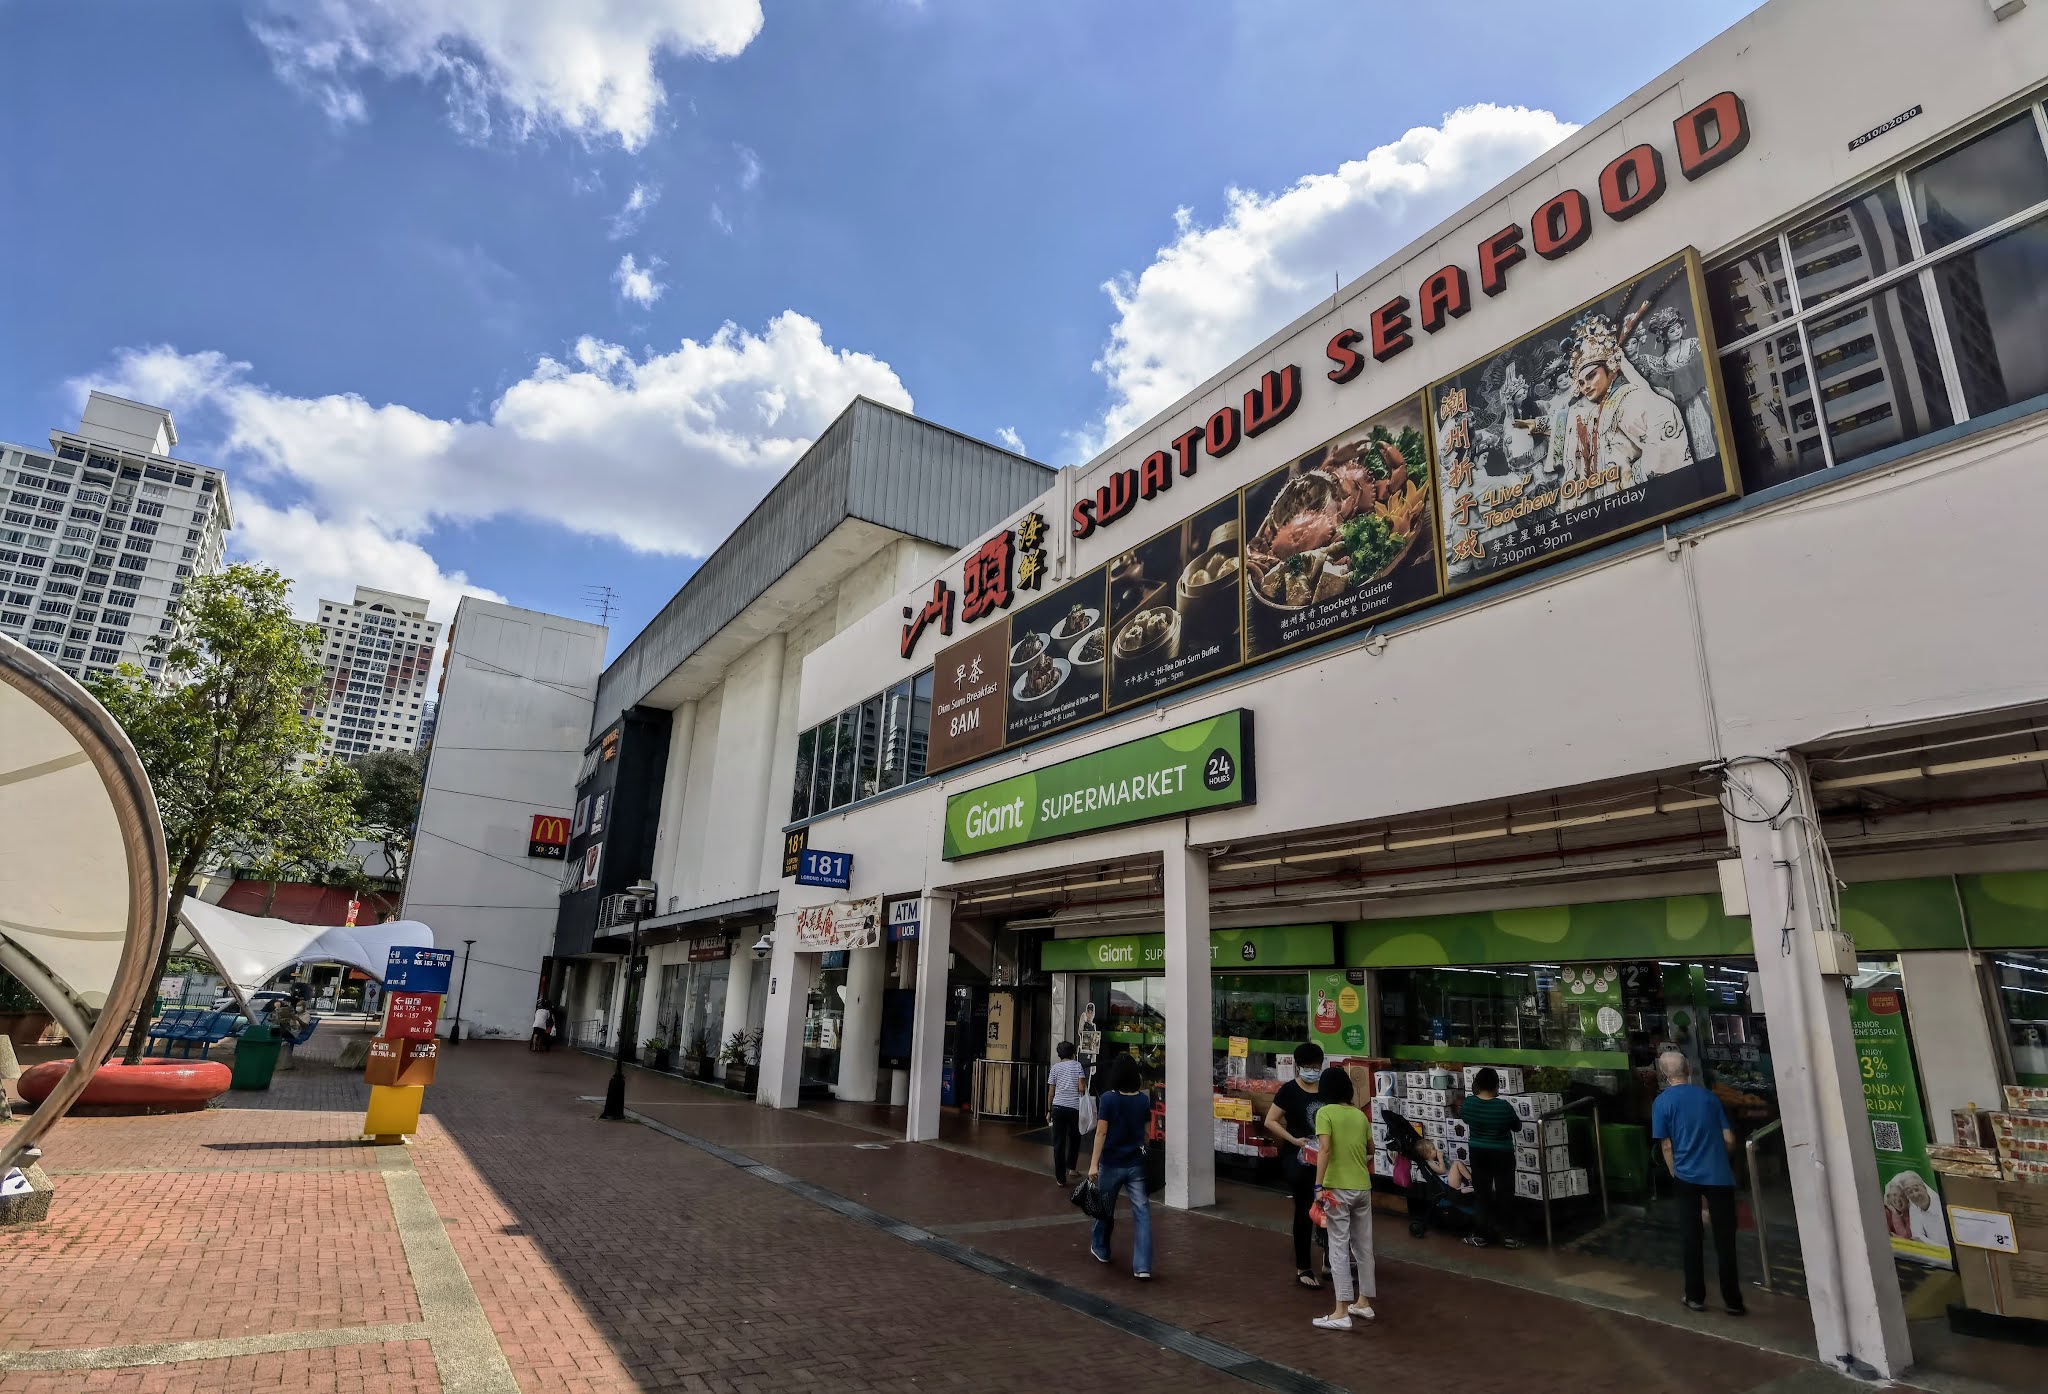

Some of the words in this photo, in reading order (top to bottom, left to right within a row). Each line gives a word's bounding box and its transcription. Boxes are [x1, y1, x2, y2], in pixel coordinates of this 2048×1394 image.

[1852, 108, 1917, 148] 2010/02080
[1072, 363, 1302, 539] SWATOW
[1326, 90, 1751, 385] SEAFOOD
[1483, 487, 1562, 530] Teochew
[1560, 465, 1621, 499] Opera
[1565, 505, 1602, 525] Every
[1604, 487, 1647, 511] Friday
[1490, 543, 1537, 568] 7.30pm
[1318, 594, 1358, 615] Teochew
[1358, 580, 1394, 600] Cuisine
[1282, 628, 1300, 641] 6pm
[1305, 614, 1339, 632] 10.30pm
[1361, 595, 1390, 613] Dinner
[1156, 663, 1174, 676] Hi-Tea
[1174, 658, 1187, 669] Dim
[1187, 653, 1201, 664] Sum
[1201, 645, 1220, 659] Buffet
[953, 654, 985, 691] 早茶
[1154, 676, 1167, 687] 3pm
[1170, 670, 1184, 681] 5pm
[937, 703, 951, 716] Dim
[951, 697, 966, 709] Sum
[966, 681, 998, 703] Breakfast
[1079, 696, 1089, 705] Dim
[1088, 692, 1100, 701] Sum
[949, 707, 980, 738] 8AM
[1062, 709, 1077, 720] Lunch
[1208, 755, 1230, 776] 24
[1208, 773, 1231, 785] HOURS
[965, 796, 1024, 839] Giant
[1040, 764, 1188, 823] SUPERMARKET
[547, 846, 560, 856] 24
[788, 832, 804, 855] 181
[808, 854, 843, 877] 181
[800, 874, 820, 882] LORONG
[895, 901, 918, 922] ATM
[902, 925, 915, 937] UOB
[1098, 944, 1134, 963] Giant
[1243, 945, 1254, 955] 24
[1852, 1020, 1880, 1028] SENIOR
[1869, 1028, 1899, 1036] SPECIAL
[1861, 1048, 1882, 1056] ENJOY
[1862, 1083, 1906, 1096] ONDAY
[1866, 1098, 1903, 1111] RIDAY
